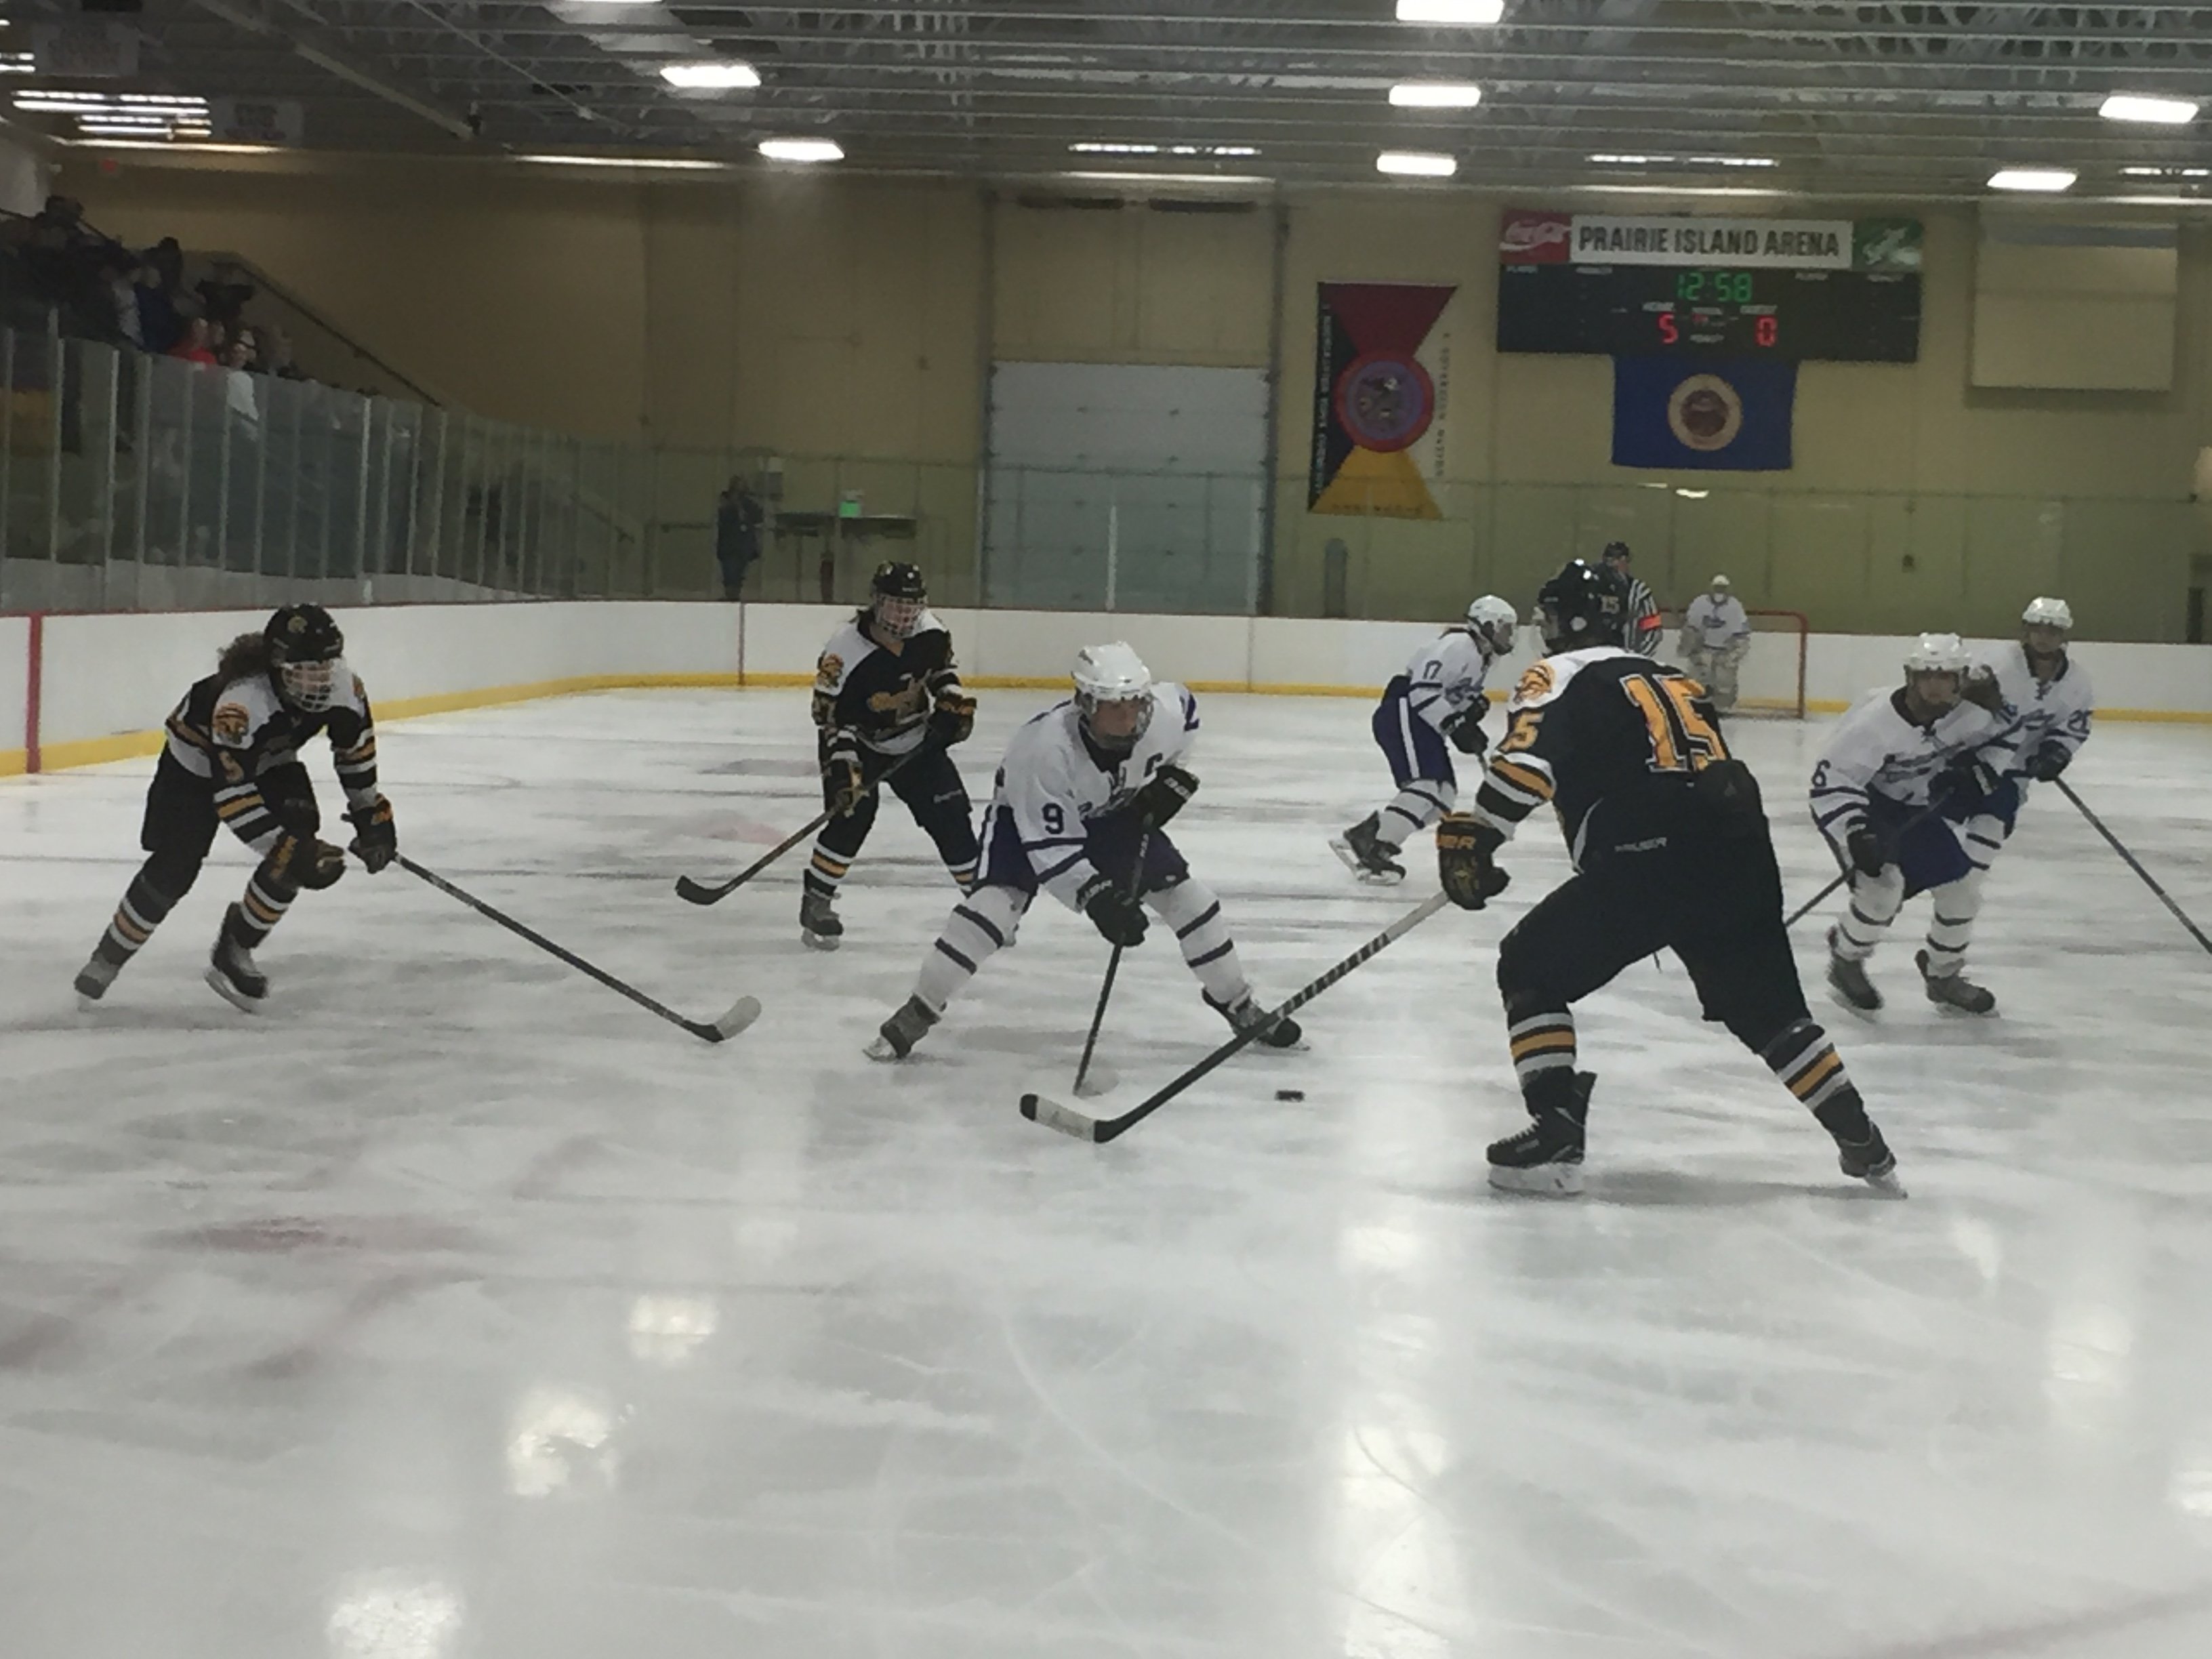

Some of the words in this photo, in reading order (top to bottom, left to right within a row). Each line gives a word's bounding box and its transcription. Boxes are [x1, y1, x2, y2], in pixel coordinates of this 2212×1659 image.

[1578, 226, 1668, 253] PRAIRIE
[1674, 228, 1759, 255] ISLAND
[1763, 230, 1839, 257] ARENA
[1658, 313, 1679, 344] 5
[1755, 315, 1778, 346] 0
[1619, 674, 1727, 773] 15
[1042, 802, 1065, 835] 9
